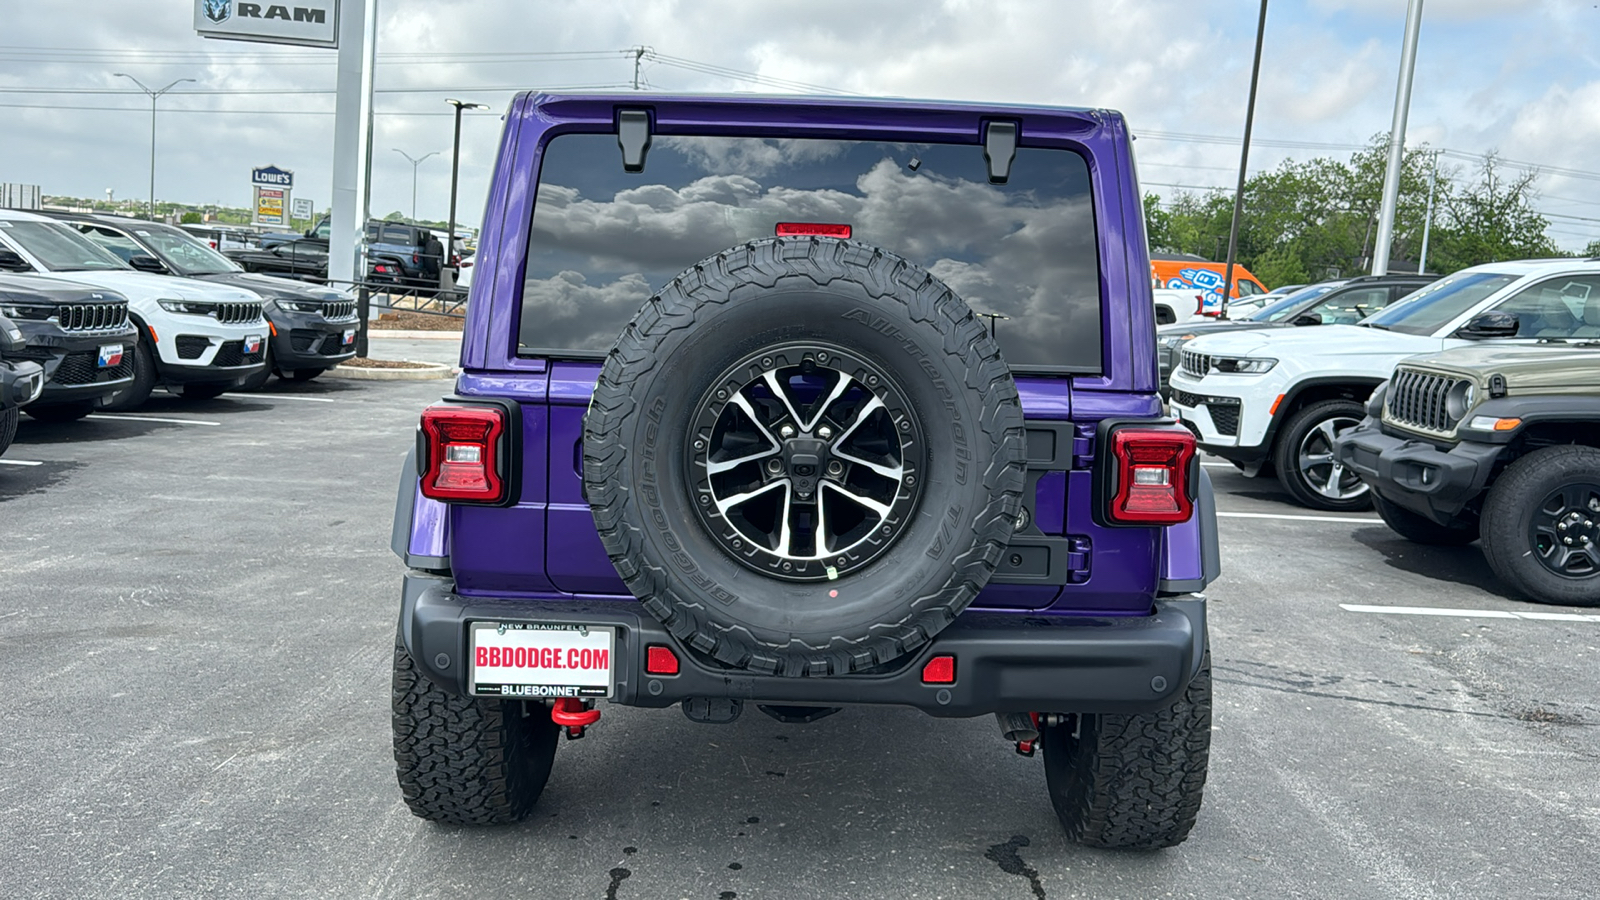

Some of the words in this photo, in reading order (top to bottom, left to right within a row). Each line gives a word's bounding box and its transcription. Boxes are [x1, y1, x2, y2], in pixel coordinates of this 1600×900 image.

[238, 2, 326, 24] RAM
[254, 170, 290, 184] LOWE'S
[841, 307, 971, 486] All-Terrain
[640, 395, 739, 606] BFGoodrich
[925, 504, 964, 560] T/A
[526, 623, 586, 631] BRAUNFELS
[475, 646, 609, 670] BBDODGE.COM
[501, 685, 580, 696] BLUEBONNET
